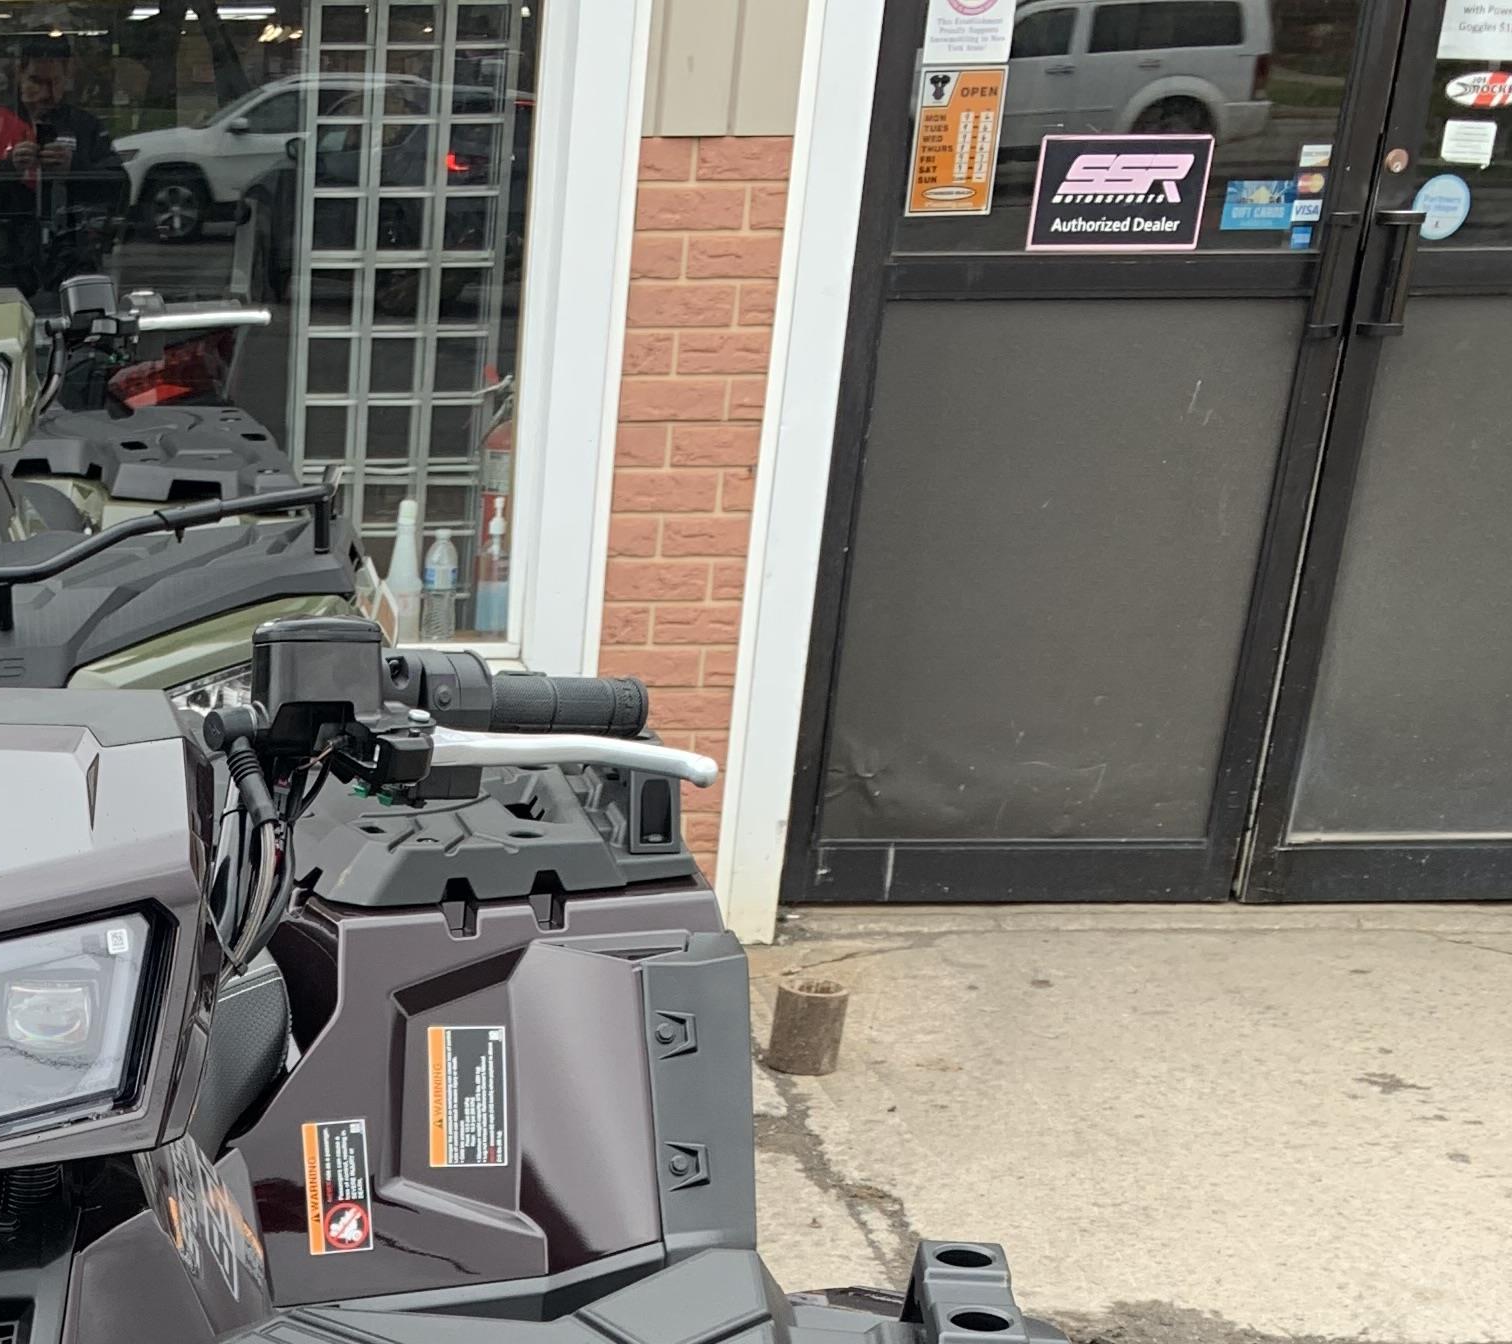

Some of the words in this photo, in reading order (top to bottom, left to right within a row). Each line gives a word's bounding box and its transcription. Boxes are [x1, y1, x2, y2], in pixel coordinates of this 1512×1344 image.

[961, 86, 998, 97] OPEN
[921, 145, 953, 153] THURS
[919, 166, 937, 174] SAT
[918, 176, 937, 184] SUN
[1056, 154, 1195, 203] SSR
[1051, 195, 1165, 203] MOTORSPORTS
[1295, 205, 1319, 216] VISA
[1050, 217, 1130, 232] Authorized
[1132, 217, 1180, 232] Dealer
[433, 1063, 443, 1115] WARNING
[308, 1157, 320, 1212] WARNING
